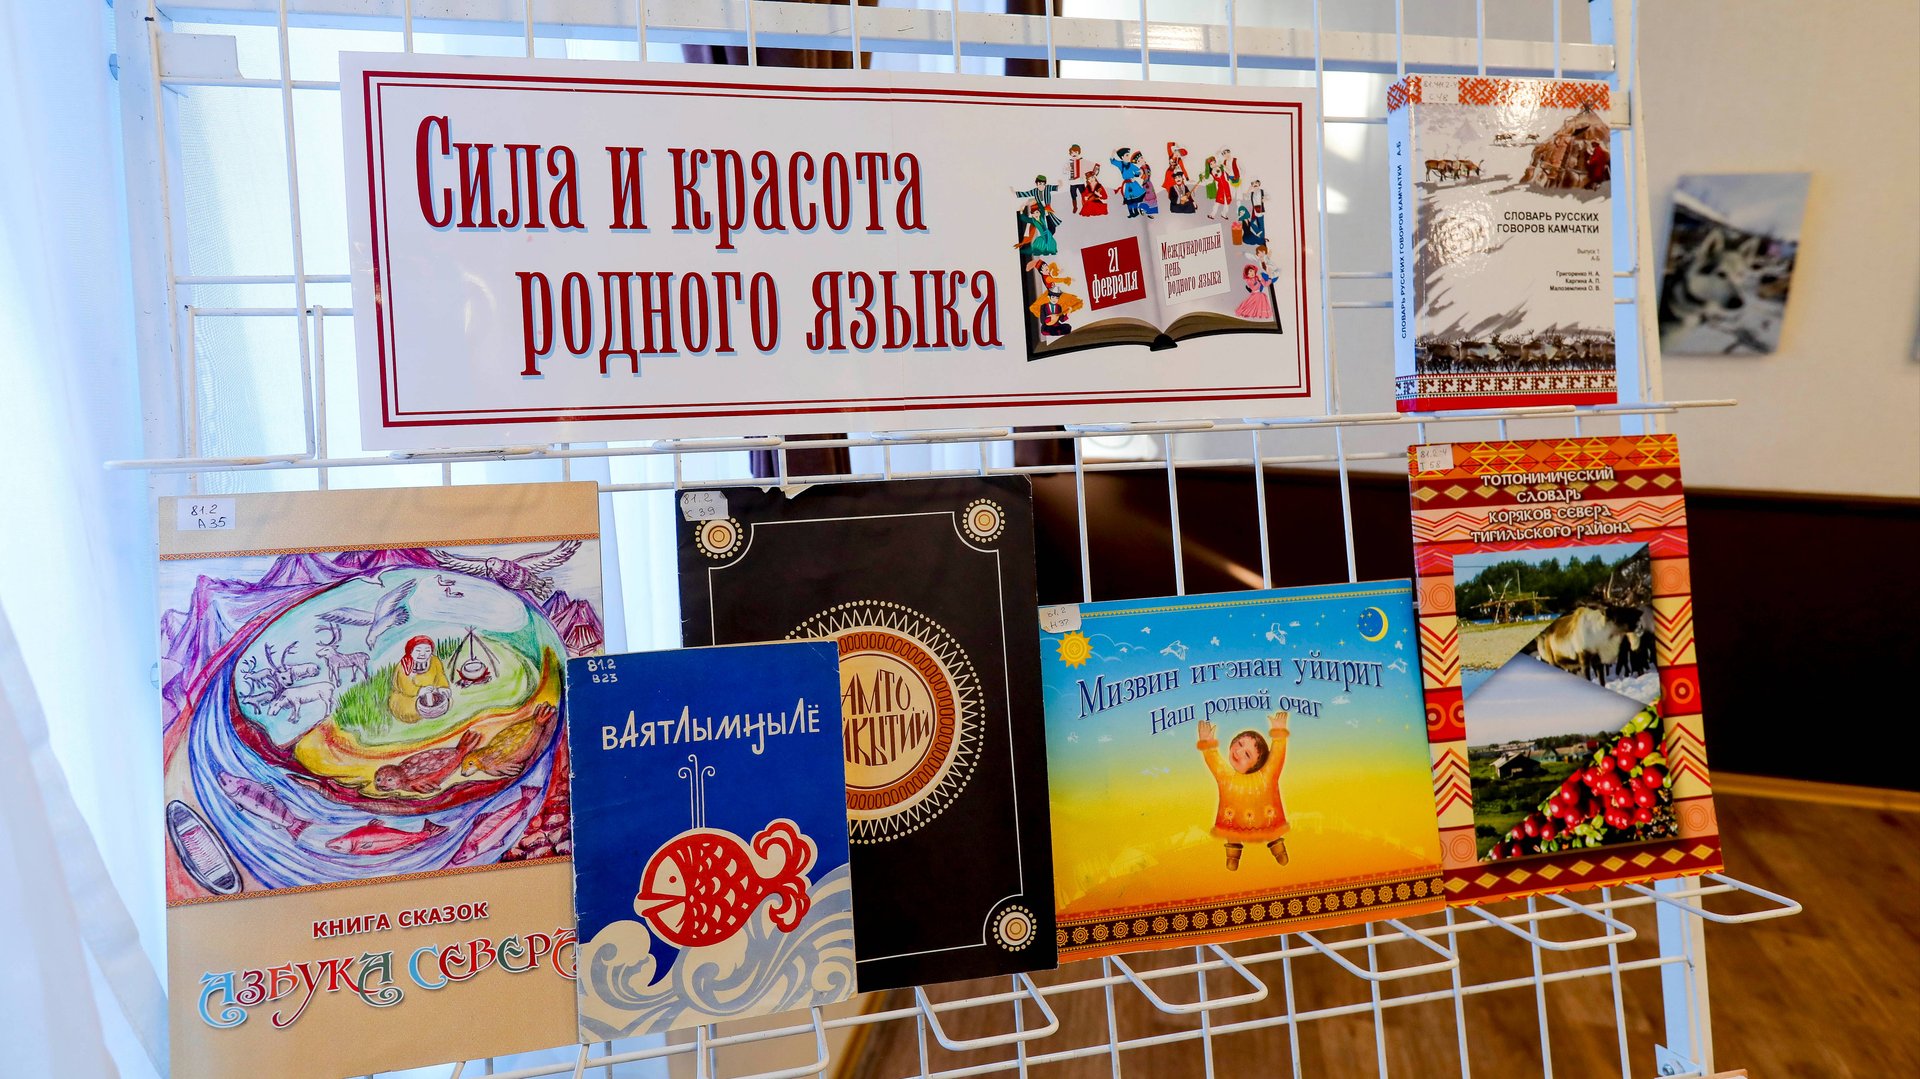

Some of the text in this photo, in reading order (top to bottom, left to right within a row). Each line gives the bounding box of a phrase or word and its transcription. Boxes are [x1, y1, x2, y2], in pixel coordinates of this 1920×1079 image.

[415, 115, 931, 253] Сила и красота
[1497, 223, 1600, 234] ГОВОРОВ КАМЧАТКИ
[1503, 211, 1600, 222] СЛОВАРЬ РУССКИХ
[1107, 246, 1120, 273] 21
[1161, 231, 1222, 261] Международный
[1164, 262, 1182, 281] день
[1167, 270, 1222, 299] родного языка
[1091, 270, 1139, 303] февраля
[516, 269, 1006, 379] родного языка
[1480, 466, 1614, 487] ТОПОНИМИЧЕСКИЙ
[1516, 489, 1582, 504] СЛОВАРЬ
[1487, 504, 1612, 525] КОРЯКОВ СЕВЕРА
[1469, 521, 1633, 545] ТИГИЛЬСКОГО РАЙОНА
[1076, 667, 1181, 720] Мизвин
[1291, 650, 1385, 693] уйирит
[1149, 688, 1323, 736] Наш родной очаг
[312, 901, 489, 940] КНИГА СКАЗОК
[197, 950, 405, 1030] АЗБУКА
